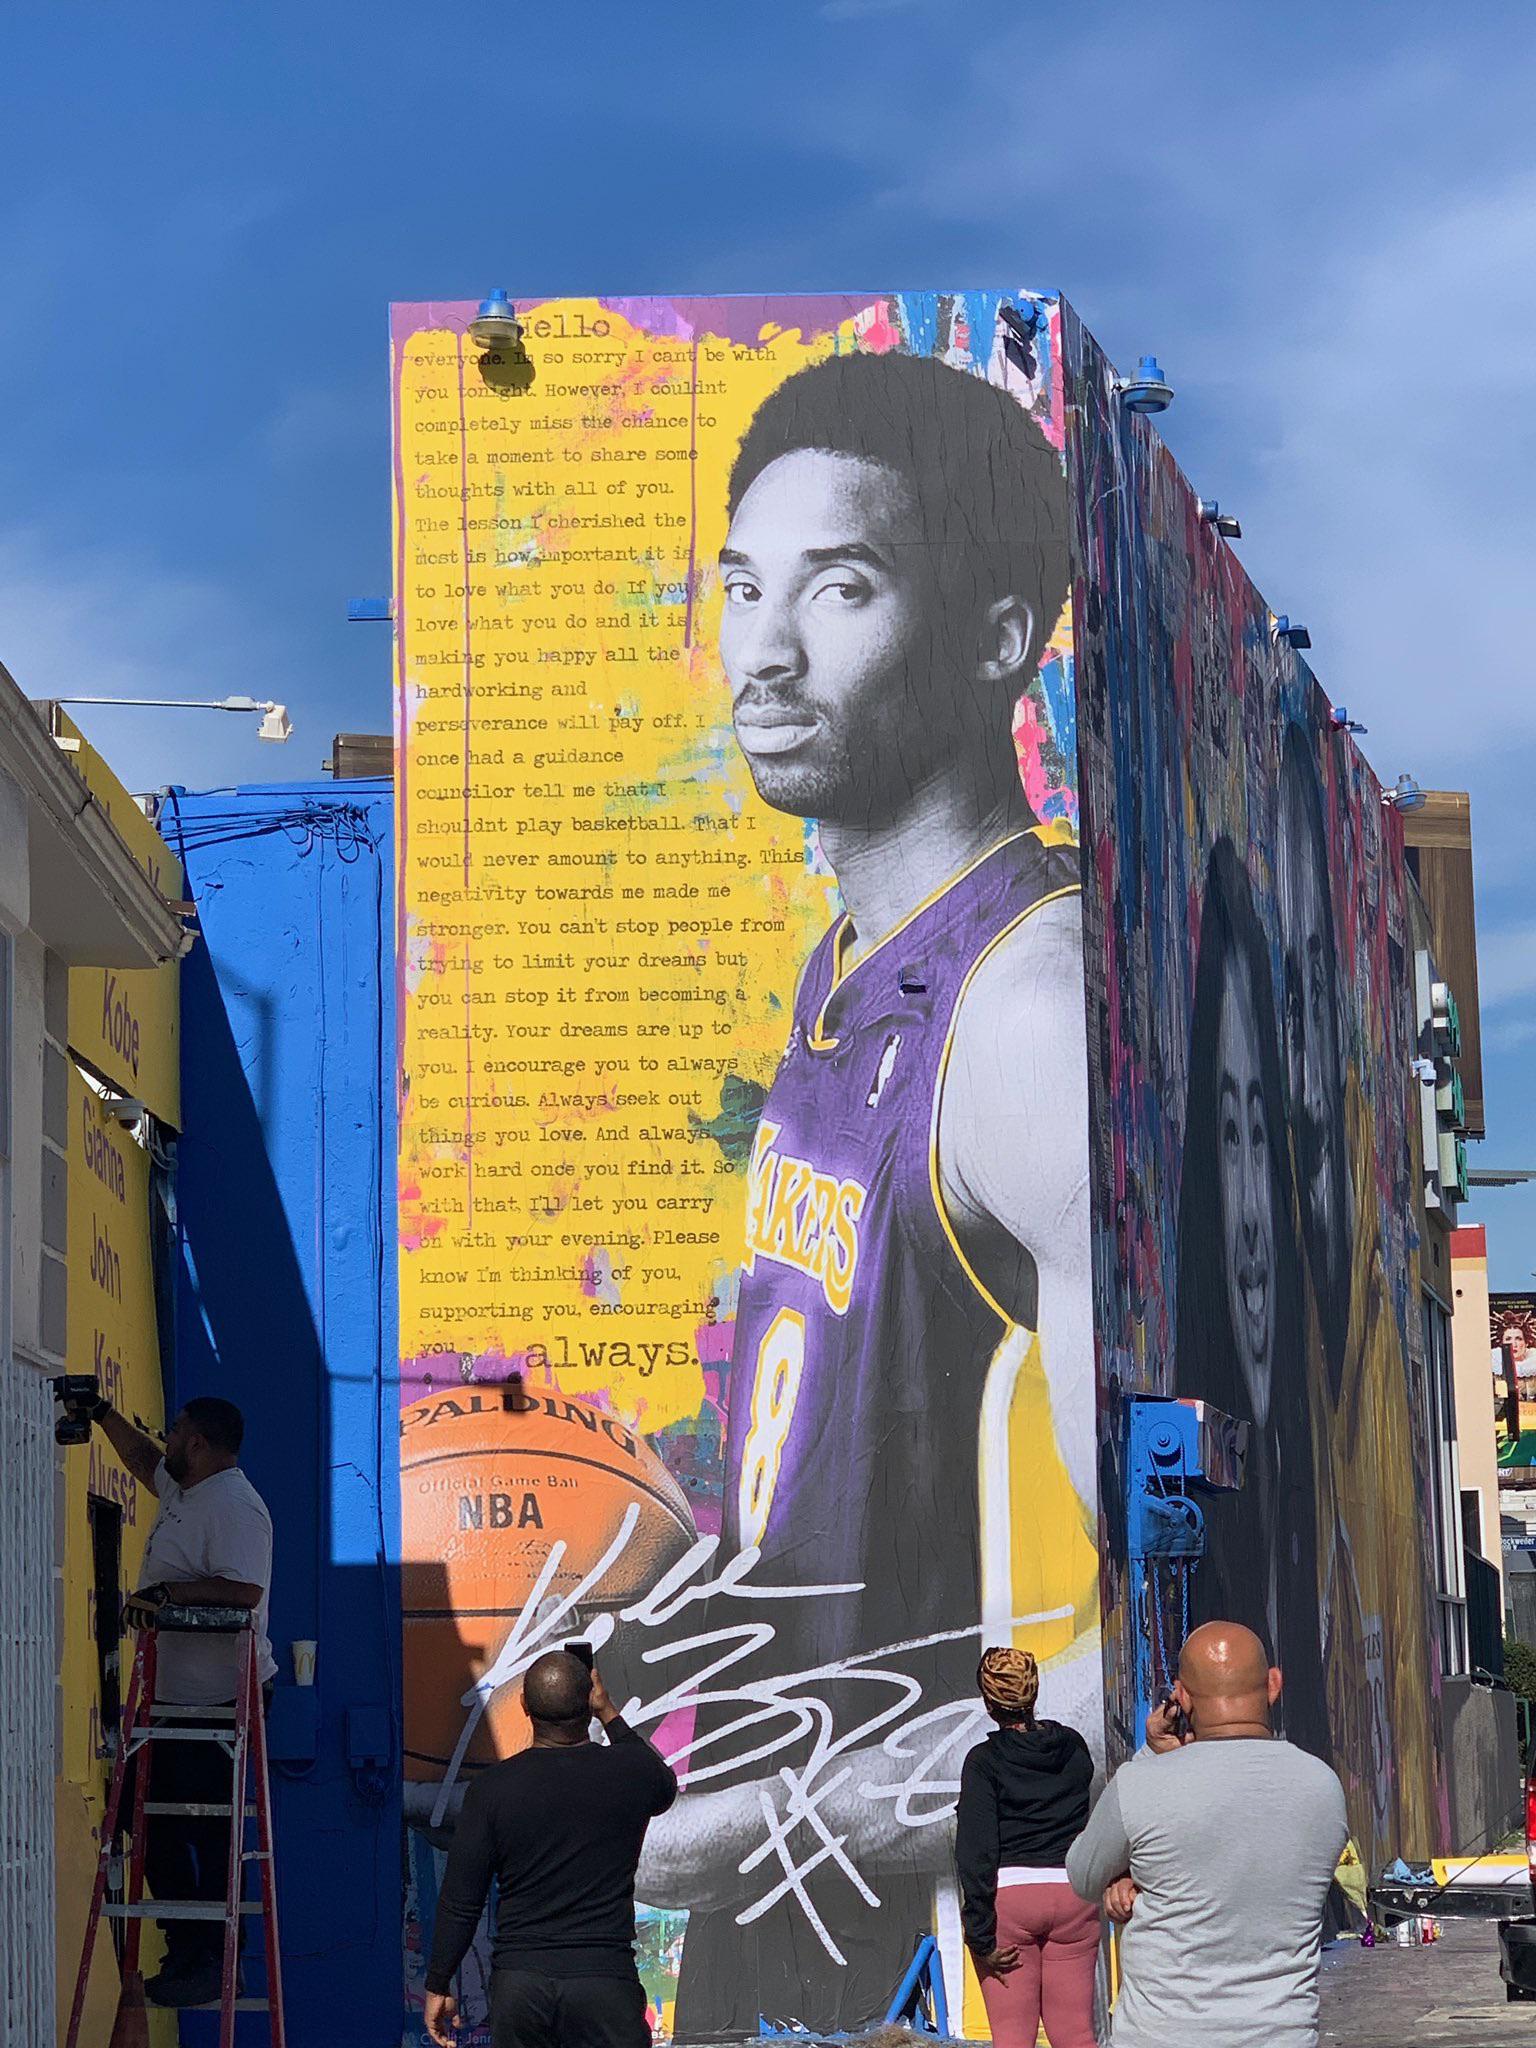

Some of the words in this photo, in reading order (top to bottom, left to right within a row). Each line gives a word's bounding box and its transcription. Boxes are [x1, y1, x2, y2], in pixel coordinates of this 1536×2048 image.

[543, 352, 564, 364] so
[572, 351, 627, 367] sorry
[704, 347, 725, 362] be
[732, 347, 777, 362] with
[415, 388, 448, 403] you
[545, 383, 626, 397] However,
[650, 381, 728, 395] couldnt
[415, 417, 522, 435] completely
[530, 417, 573, 430] miss
[581, 414, 613, 429] the
[622, 414, 689, 429] chance
[415, 450, 459, 466] take
[487, 449, 553, 464] moment
[562, 448, 583, 463] to
[591, 447, 647, 463] share
[655, 449, 699, 461] some
[415, 483, 505, 502] thoughts
[512, 481, 555, 497] with
[564, 481, 598, 496] all
[606, 480, 627, 495] of
[636, 483, 675, 498] you.
[415, 517, 450, 533] The
[457, 516, 522, 531] lesson
[548, 512, 646, 529] cherished
[654, 512, 687, 527] the
[415, 549, 460, 566] most
[540, 546, 639, 565] important
[415, 583, 436, 599] to
[444, 583, 487, 598] love
[495, 581, 543, 597] what
[551, 583, 586, 599] you
[415, 618, 459, 632] love
[468, 615, 514, 630] what
[522, 618, 557, 633] you
[565, 614, 587, 629] do
[596, 613, 632, 629] and
[639, 612, 660, 628] it
[667, 612, 688, 627] is
[415, 650, 486, 669] making
[494, 652, 530, 667] you
[537, 647, 598, 666] happy
[605, 647, 639, 662] all
[647, 645, 680, 662] the
[415, 682, 544, 700] hardworking
[551, 680, 588, 697] and
[415, 717, 549, 737] perseverance
[558, 715, 600, 730] will
[608, 715, 644, 733] pay
[652, 713, 688, 729] off.
[416, 753, 460, 767] once
[467, 749, 505, 766] had
[533, 749, 624, 769] guidance
[416, 784, 516, 801] councilor
[523, 782, 565, 799] tell
[573, 784, 596, 797] me
[603, 781, 649, 798] that
[416, 817, 509, 835] shouldnt
[516, 817, 563, 836] play
[572, 815, 686, 832] basketball.
[693, 814, 739, 832] That
[417, 852, 475, 869] would
[482, 853, 540, 867] never
[547, 850, 619, 867] amount
[625, 850, 648, 866] to
[655, 849, 752, 869] anything.
[759, 849, 805, 864] This
[417, 886, 527, 907] negativity
[534, 884, 614, 901] towards
[622, 886, 645, 899] me
[653, 882, 700, 898] made
[707, 885, 732, 898] me
[416, 921, 510, 940] stronger.
[518, 919, 552, 935] You
[559, 917, 609, 935] can't
[615, 918, 660, 937] stop
[667, 917, 734, 936] people
[740, 917, 786, 933] from
[417, 955, 485, 974] trying
[493, 954, 514, 970] to
[522, 953, 576, 970] limit
[583, 954, 630, 973] your
[638, 952, 707, 969] dreams
[715, 951, 749, 967] but
[417, 991, 453, 1010] you
[461, 991, 497, 1005] can
[505, 988, 549, 1007] stop
[556, 987, 577, 1003] it
[584, 987, 630, 1003] from
[638, 986, 729, 1006] becoming
[101, 968, 141, 1074] Kobe
[417, 1024, 499, 1044] reality.
[506, 1023, 552, 1039] Your
[560, 1022, 628, 1038] dreams
[637, 1023, 671, 1037] are
[680, 1023, 704, 1040] up
[711, 1020, 732, 1035] to
[417, 1061, 458, 1079] you.
[483, 1059, 586, 1077] encourage
[594, 1058, 631, 1076] you
[638, 1055, 659, 1072] to
[666, 1056, 739, 1075] always
[419, 1094, 440, 1109] be
[447, 1093, 531, 1109] curious.
[537, 1092, 608, 1111] Always
[615, 1090, 660, 1107] seek
[668, 1090, 703, 1105] out
[418, 1128, 487, 1148] things
[495, 1130, 530, 1147] you
[538, 1127, 588, 1142] love.
[595, 1125, 634, 1141] And
[638, 1126, 711, 1145] always
[83, 1096, 126, 1205] Gianna
[418, 1163, 468, 1179] work
[474, 1161, 523, 1178] hard
[530, 1163, 576, 1177] once
[584, 1163, 620, 1181] you
[627, 1159, 674, 1176] find
[713, 1160, 735, 1175] So
[418, 1198, 465, 1214] with
[572, 1196, 605, 1212] let
[612, 1197, 648, 1215] you
[656, 1196, 715, 1214] carry
[419, 1234, 443, 1249] on
[451, 1232, 497, 1248] with
[505, 1234, 553, 1251] your
[560, 1230, 646, 1250] evening.
[653, 1229, 721, 1245] Please
[89, 1212, 123, 1305] John
[419, 1268, 469, 1285] know
[511, 1265, 603, 1286] thinking
[611, 1265, 633, 1281] of
[419, 1303, 534, 1322] supporting
[542, 1302, 582, 1321] you,
[589, 1299, 717, 1319] encouraging
[525, 1335, 699, 1377] always.
[458, 1493, 544, 1530] NBA
